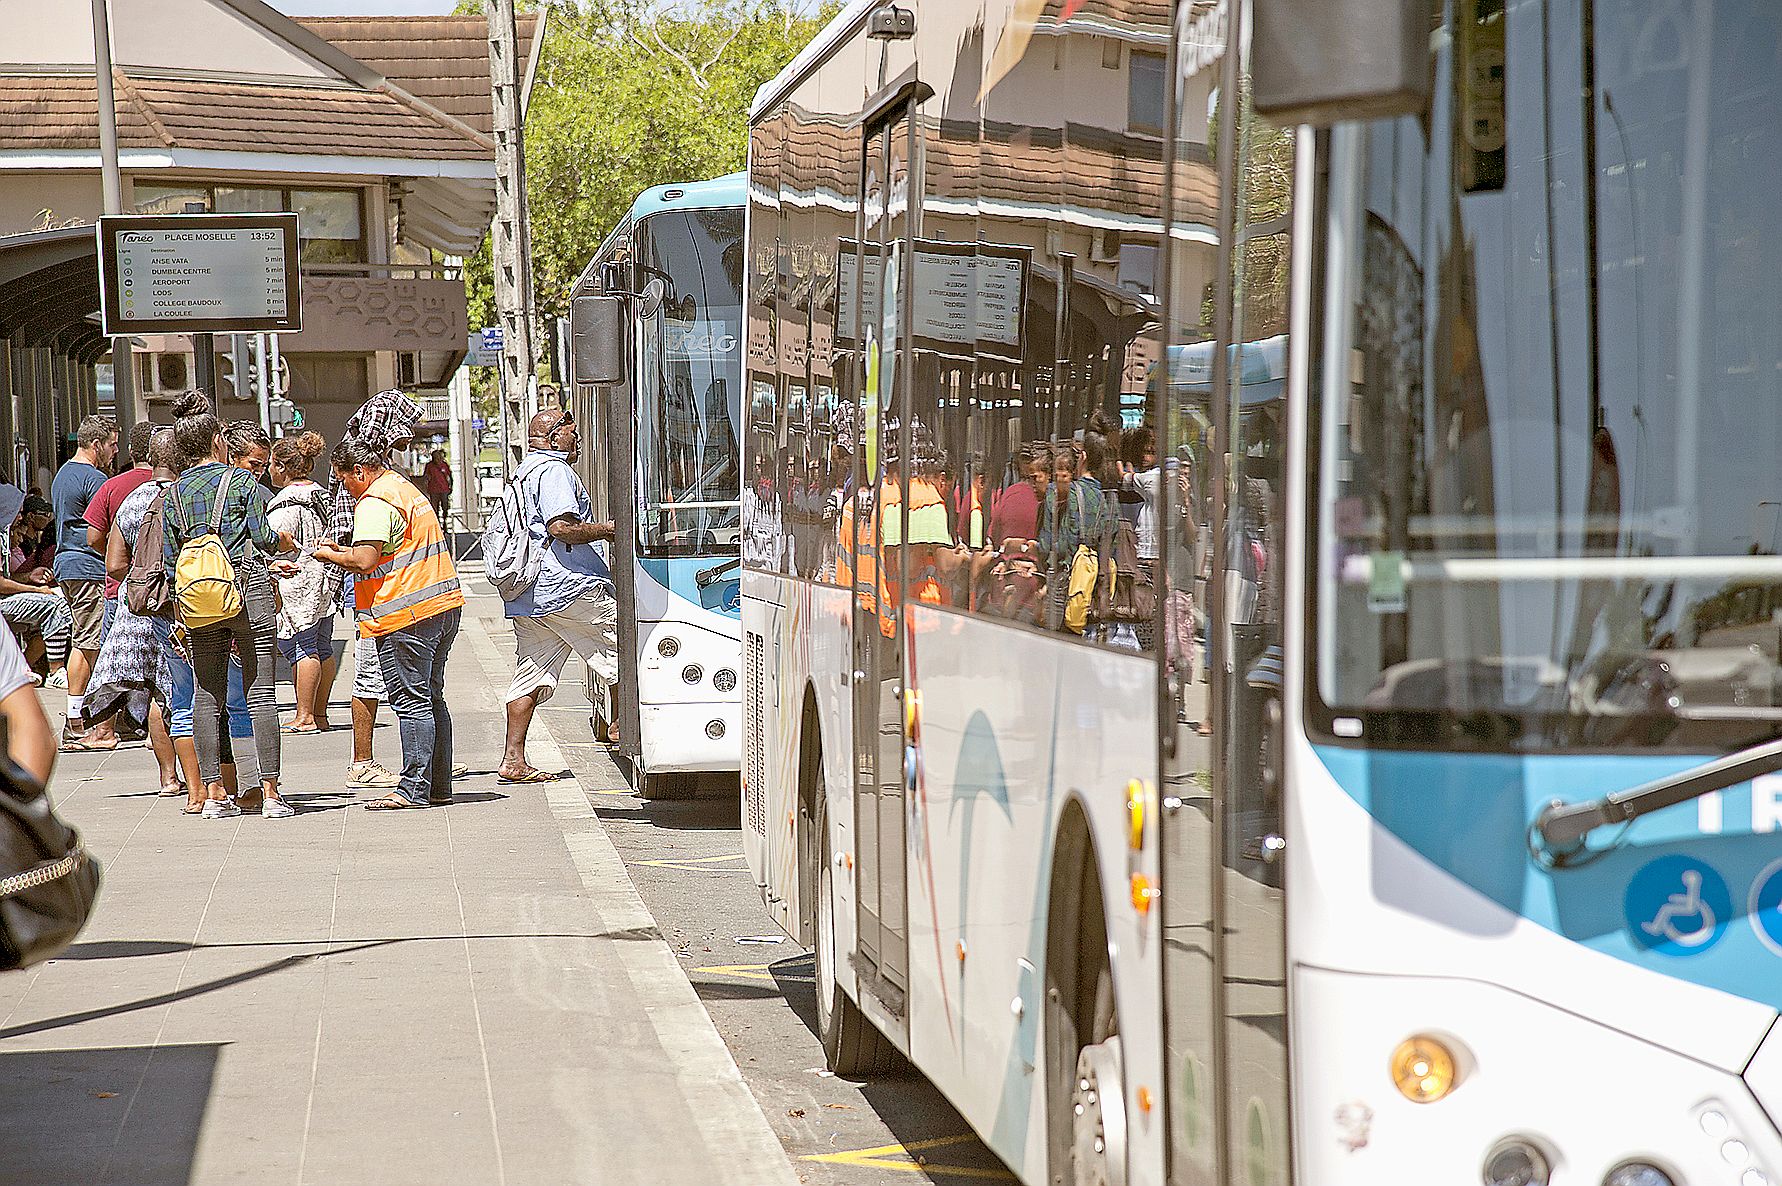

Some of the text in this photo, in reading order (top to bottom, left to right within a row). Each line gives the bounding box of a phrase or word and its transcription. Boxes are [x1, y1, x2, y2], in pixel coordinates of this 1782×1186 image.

[120, 232, 154, 244] Tanéo
[195, 233, 236, 241] MOSELLE
[250, 232, 276, 240] 13:52
